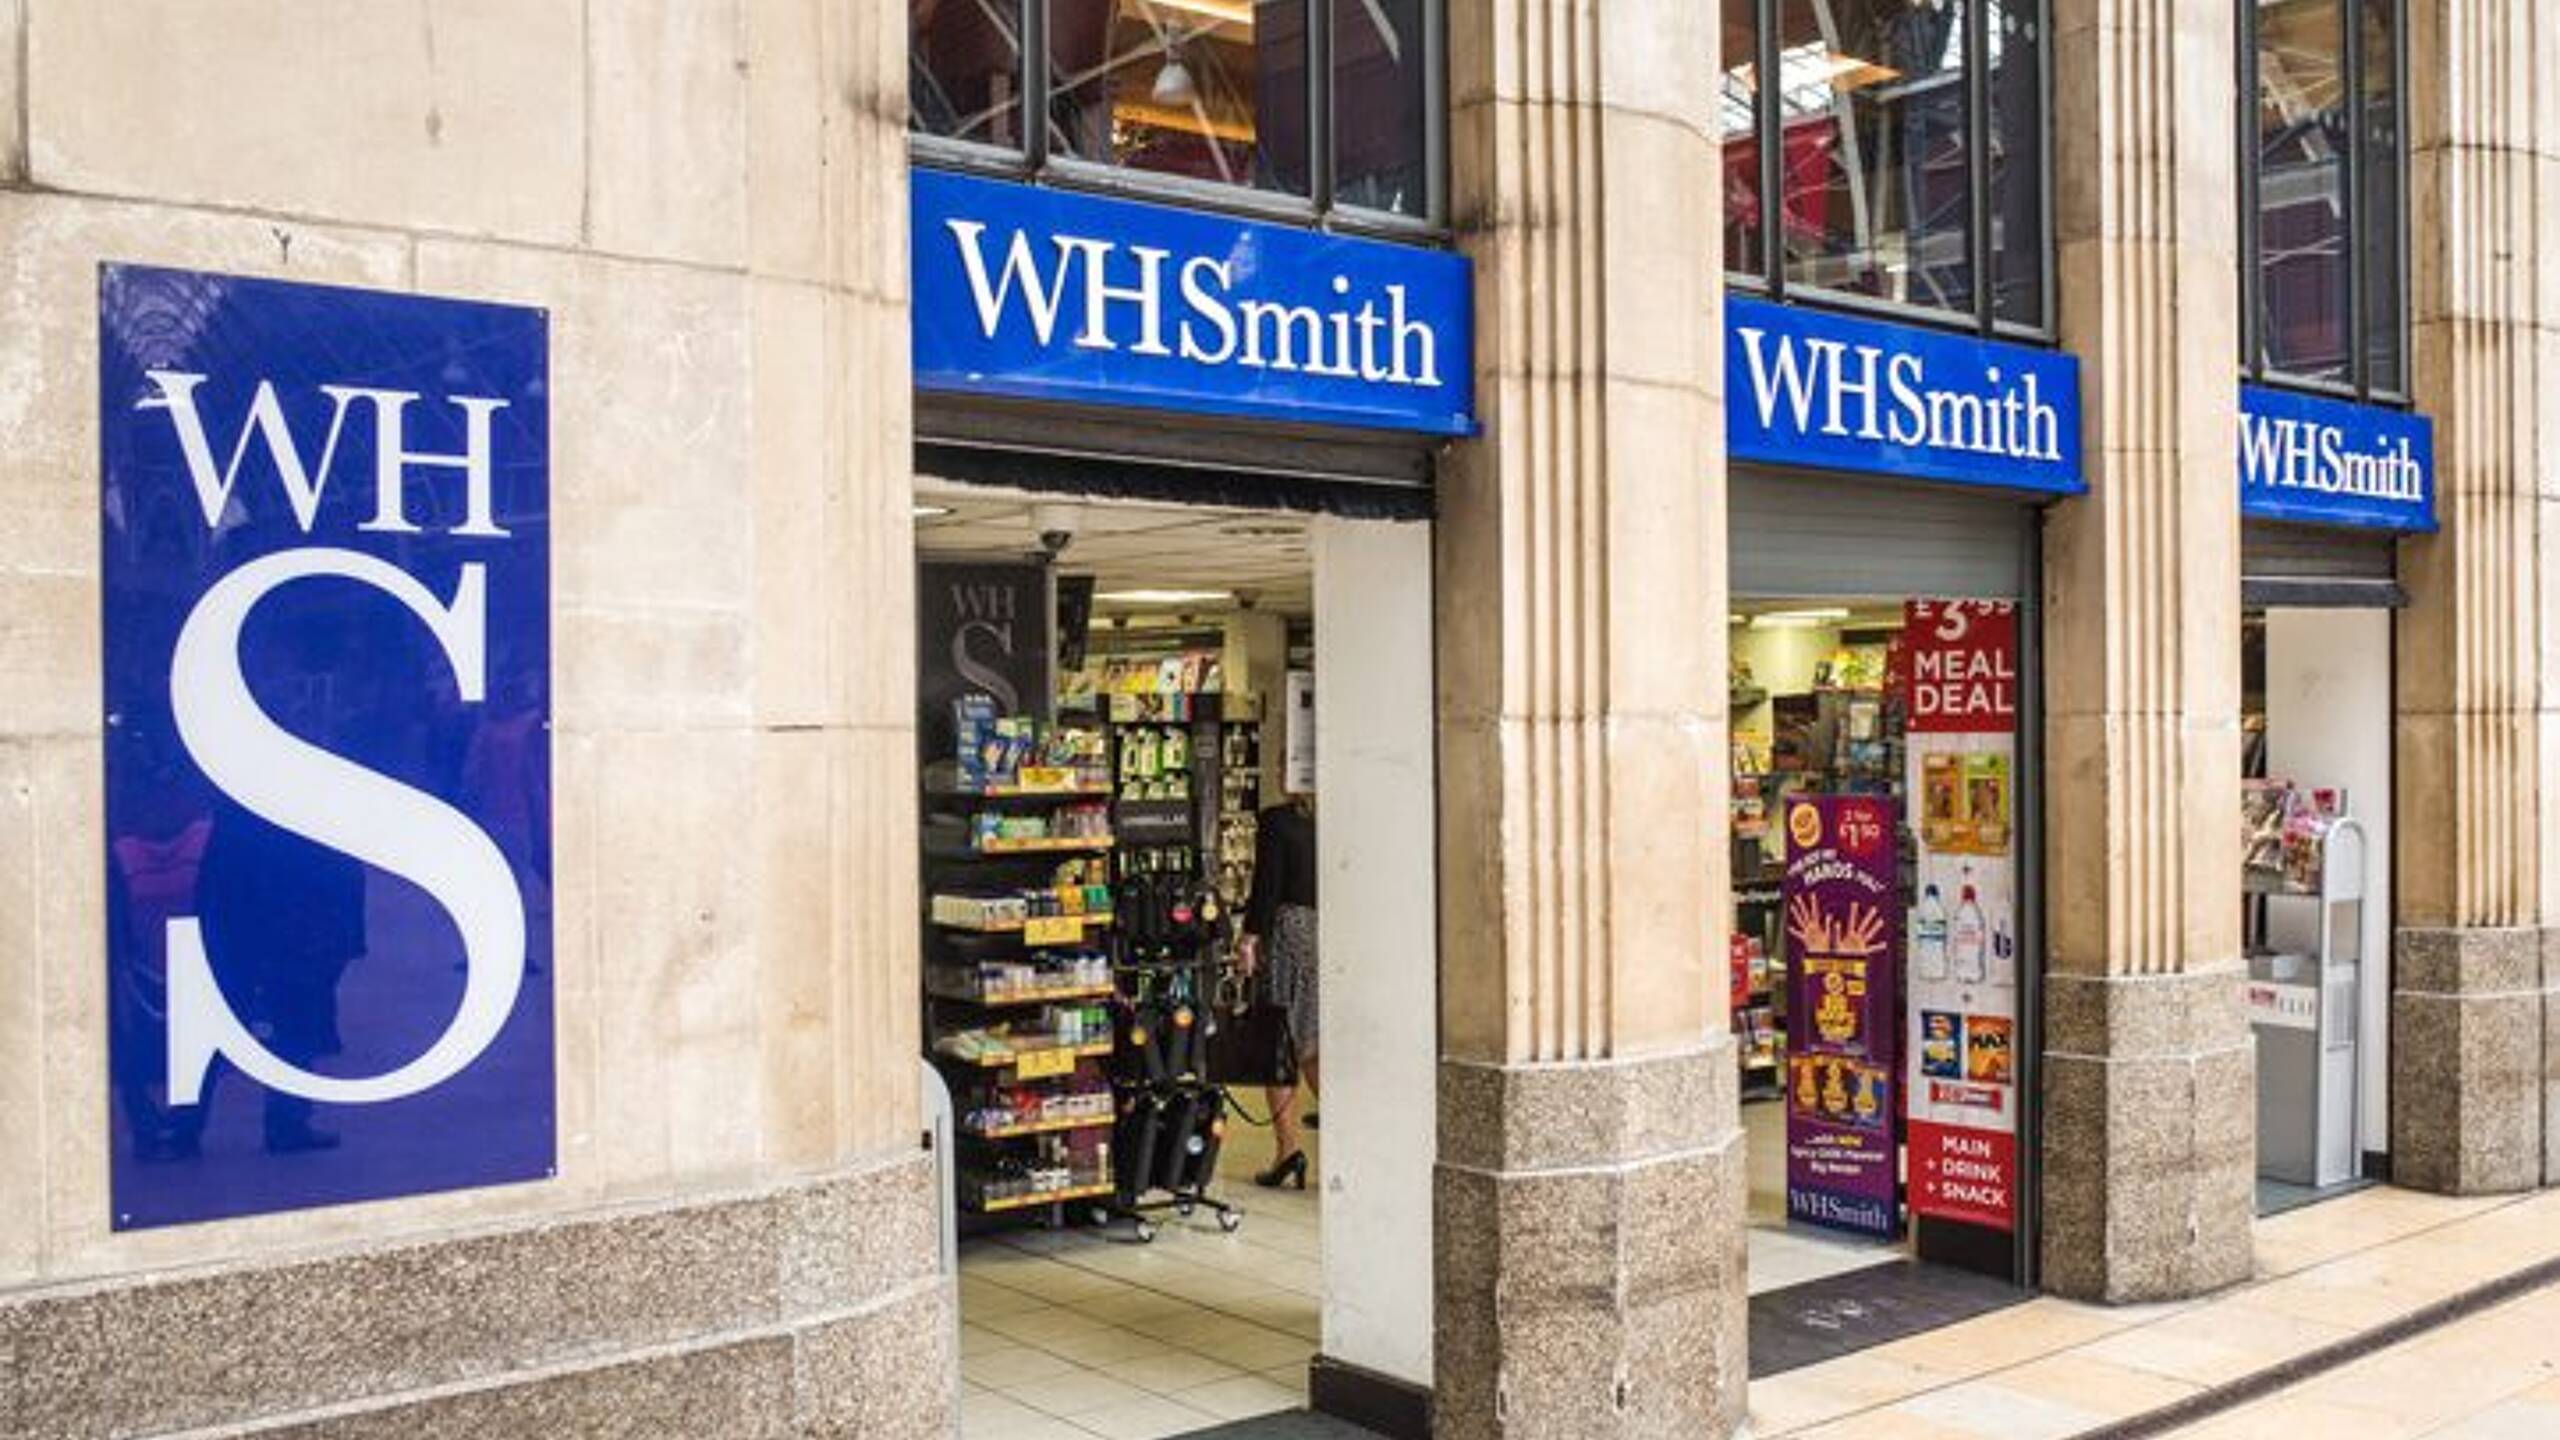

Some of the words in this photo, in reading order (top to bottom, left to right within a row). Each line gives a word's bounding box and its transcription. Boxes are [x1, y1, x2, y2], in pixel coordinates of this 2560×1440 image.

[945, 219, 1443, 387] WHSmith
[1736, 326, 2062, 461] WHSmith
[143, 369, 512, 538] WH
[2239, 411, 2424, 502] WHSmith
[951, 582, 1016, 620] WH
[1914, 648, 2015, 680] MEAL
[1915, 682, 2015, 714] DEAL
[165, 546, 526, 1106] S
[1941, 1134, 1991, 1160] MAIN
[1941, 1156, 2002, 1184] DRINK
[1790, 1188, 1888, 1231] WHSmith
[1941, 1179, 2008, 1208] SNACK
